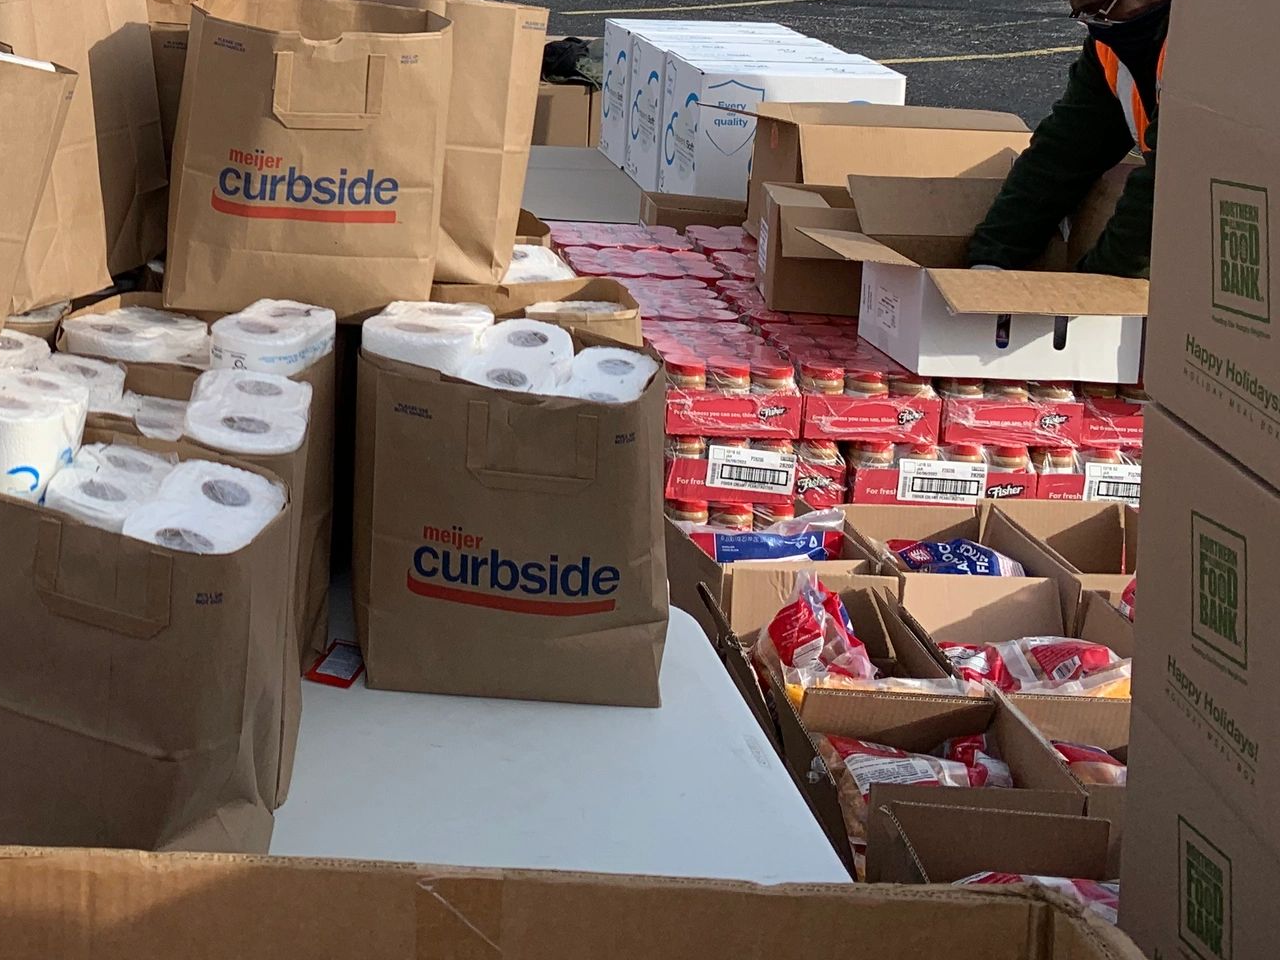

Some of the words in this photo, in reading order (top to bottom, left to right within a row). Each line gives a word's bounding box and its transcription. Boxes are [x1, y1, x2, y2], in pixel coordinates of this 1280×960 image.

[713, 117, 749, 128] quality
[229, 148, 283, 171] meijer
[219, 166, 399, 205] curbside
[1220, 217, 1260, 267] FOOD
[1220, 259, 1261, 301] BANK
[1185, 333, 1223, 376] Happy
[1225, 358, 1280, 413] Holidays
[676, 477, 689, 485] For
[690, 477, 705, 485] fres
[866, 487, 879, 495] For
[880, 487, 897, 495] fres
[987, 484, 1024, 499] Fisher
[422, 525, 483, 550] meijer
[413, 545, 620, 597] curbside
[1199, 549, 1238, 611] FOOD
[1167, 654, 1202, 705] Happy
[1204, 691, 1259, 762] Holidays!
